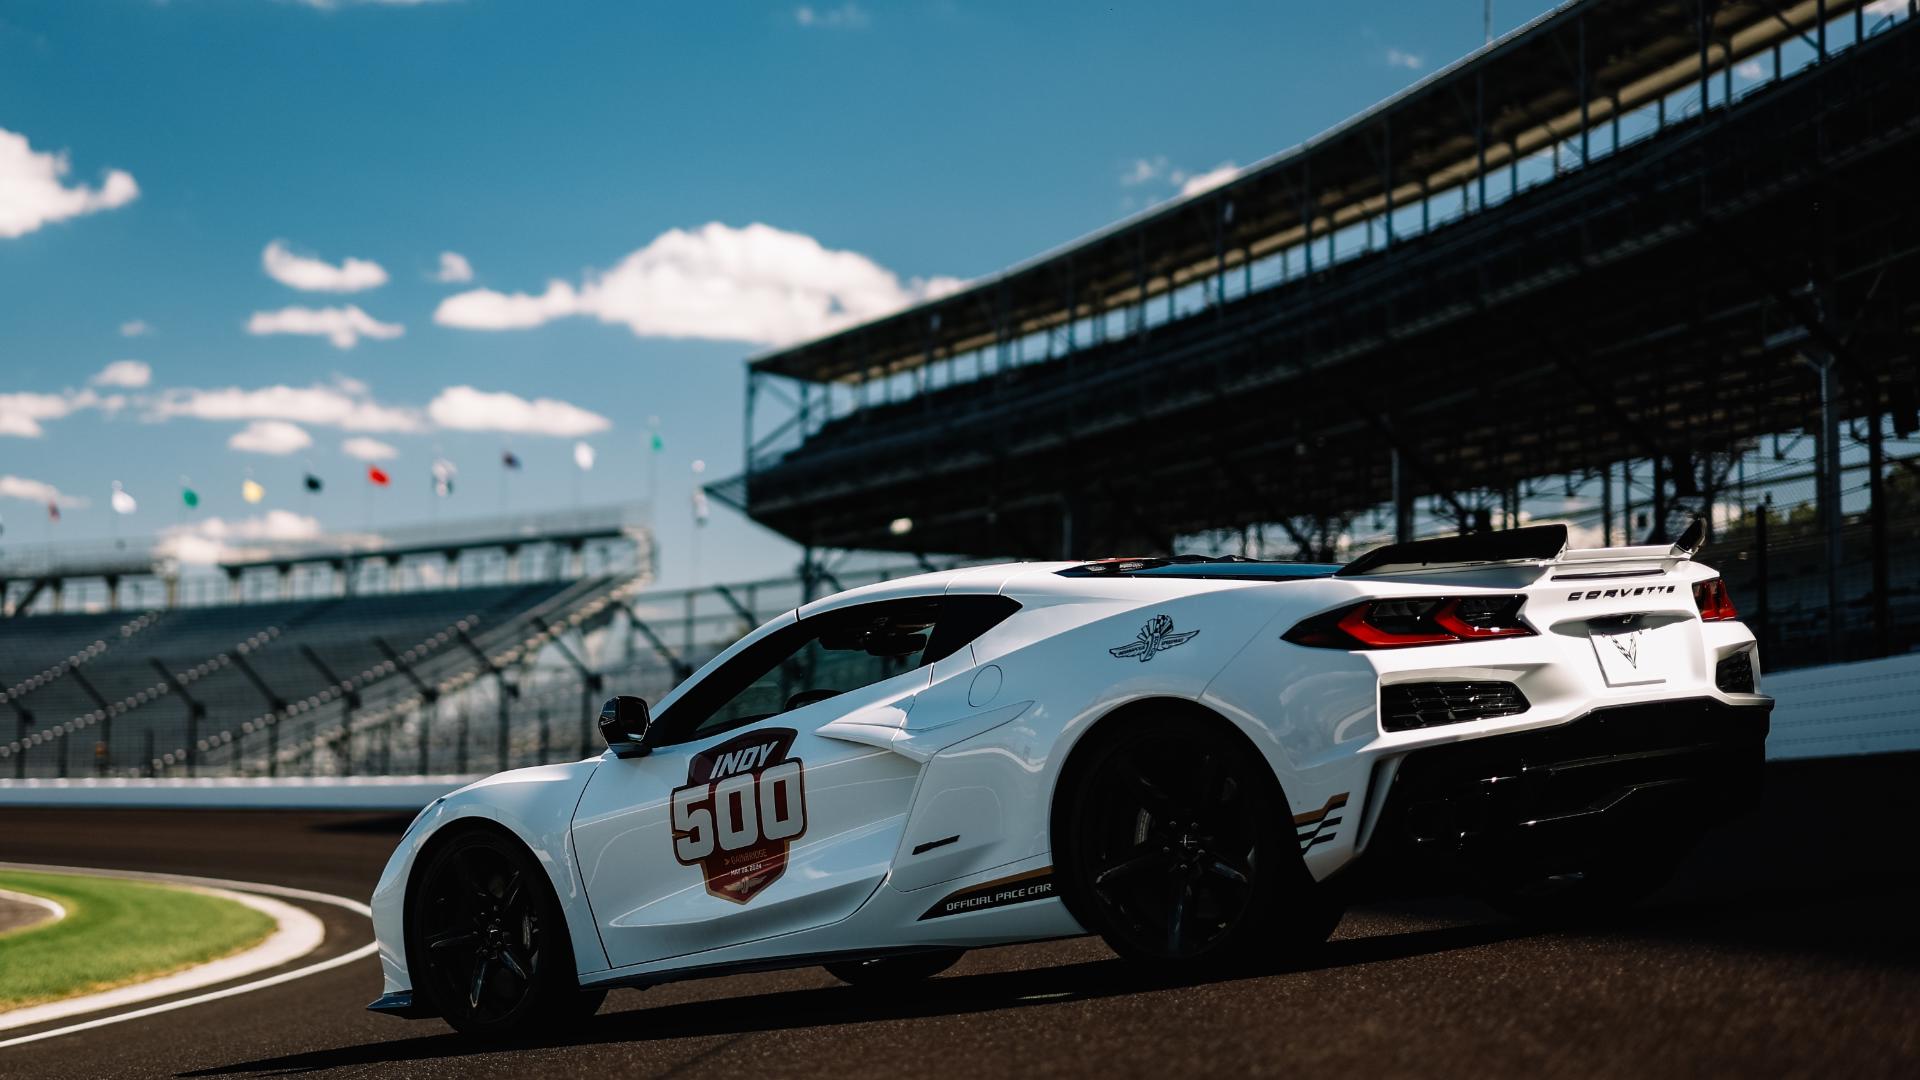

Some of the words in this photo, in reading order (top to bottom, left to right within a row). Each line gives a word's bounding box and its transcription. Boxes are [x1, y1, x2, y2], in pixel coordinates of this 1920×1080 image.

[1567, 585, 1675, 601] CORVETTE
[709, 740, 779, 779] INDY
[673, 761, 804, 861] 500
[946, 895, 993, 911] OFFICIAL
[995, 888, 1026, 901] PACE
[1027, 883, 1052, 896] CAR
